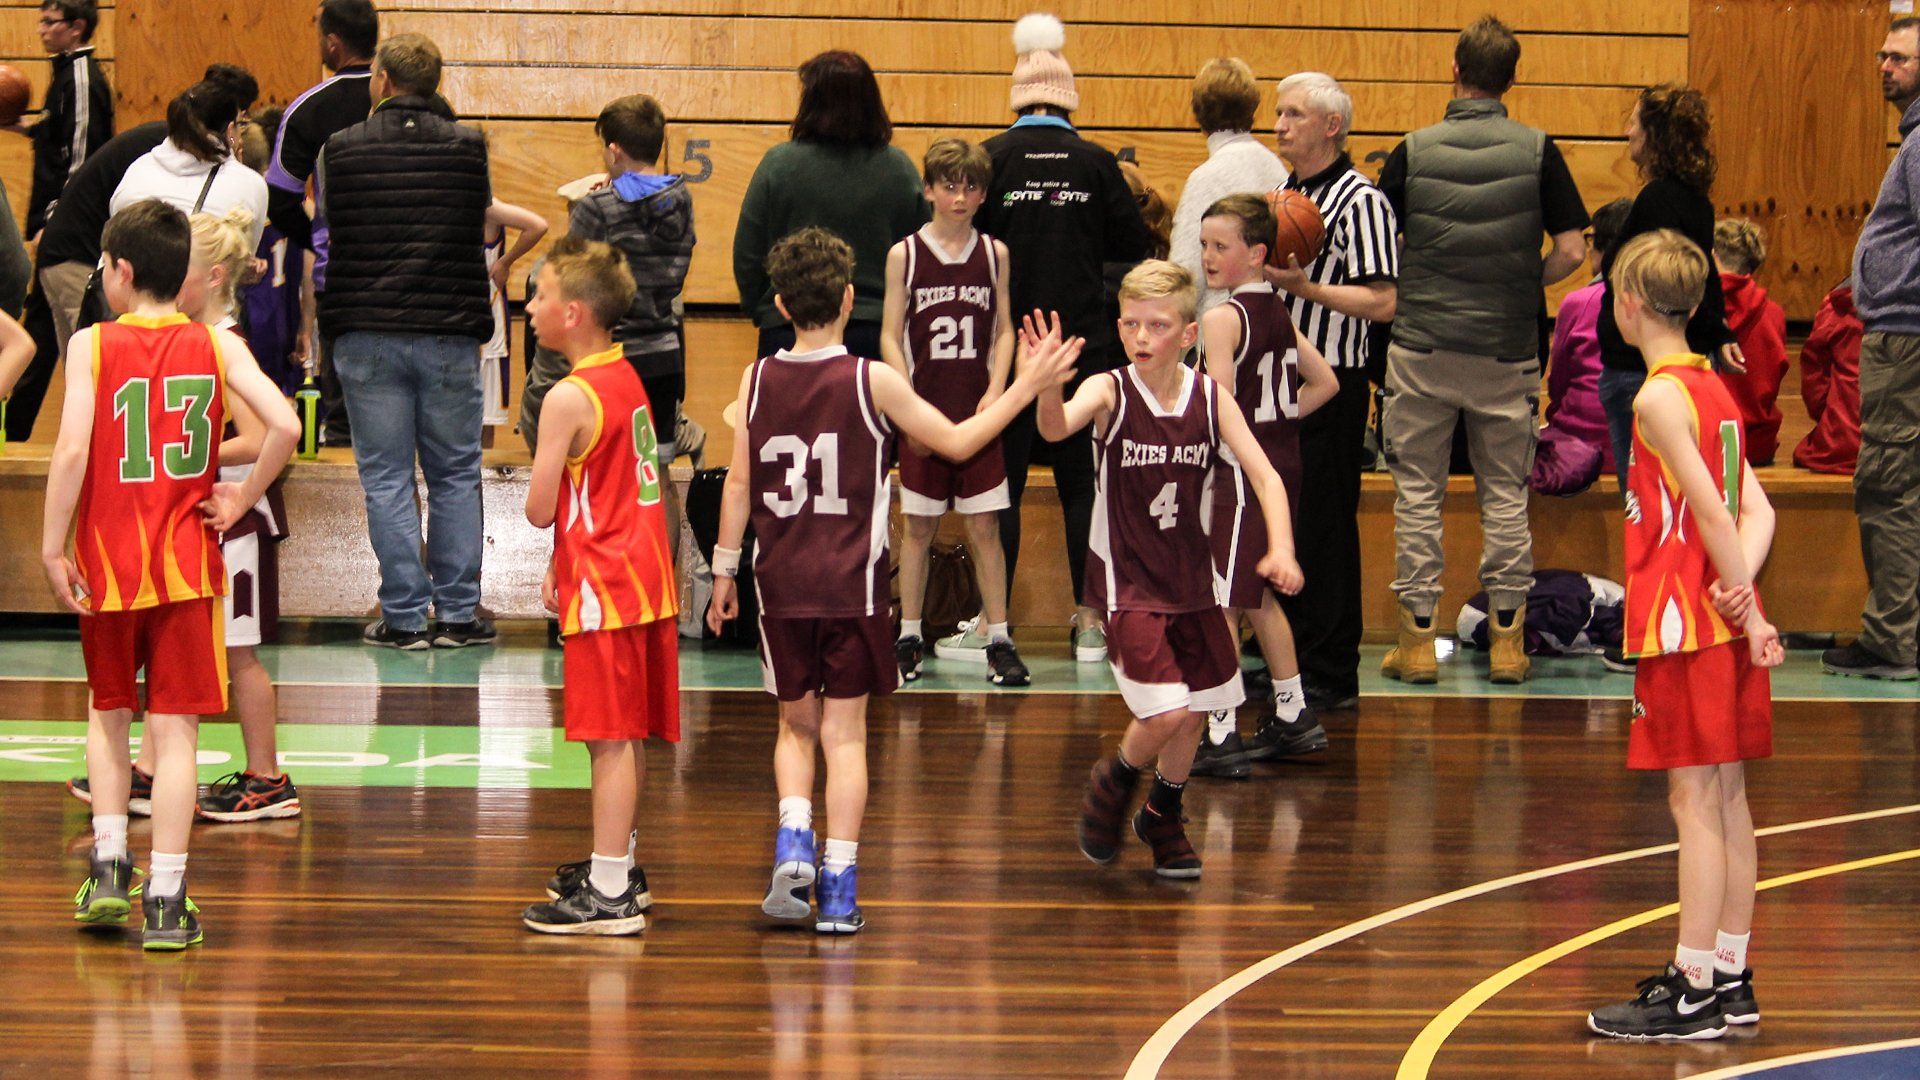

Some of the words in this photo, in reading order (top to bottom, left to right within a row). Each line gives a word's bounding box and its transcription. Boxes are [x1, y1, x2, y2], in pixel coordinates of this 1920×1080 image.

[682, 139, 713, 183] 5
[271, 236, 288, 289] 1
[915, 286, 956, 314] EXIES
[929, 315, 977, 360] 21
[1254, 347, 1299, 424] 10
[113, 374, 216, 483] 13
[631, 404, 661, 506] 8
[759, 432, 849, 518] 31
[1120, 439, 1167, 468] EXIES
[1171, 442, 1210, 469] ACMY
[1149, 482, 1179, 530] 4
